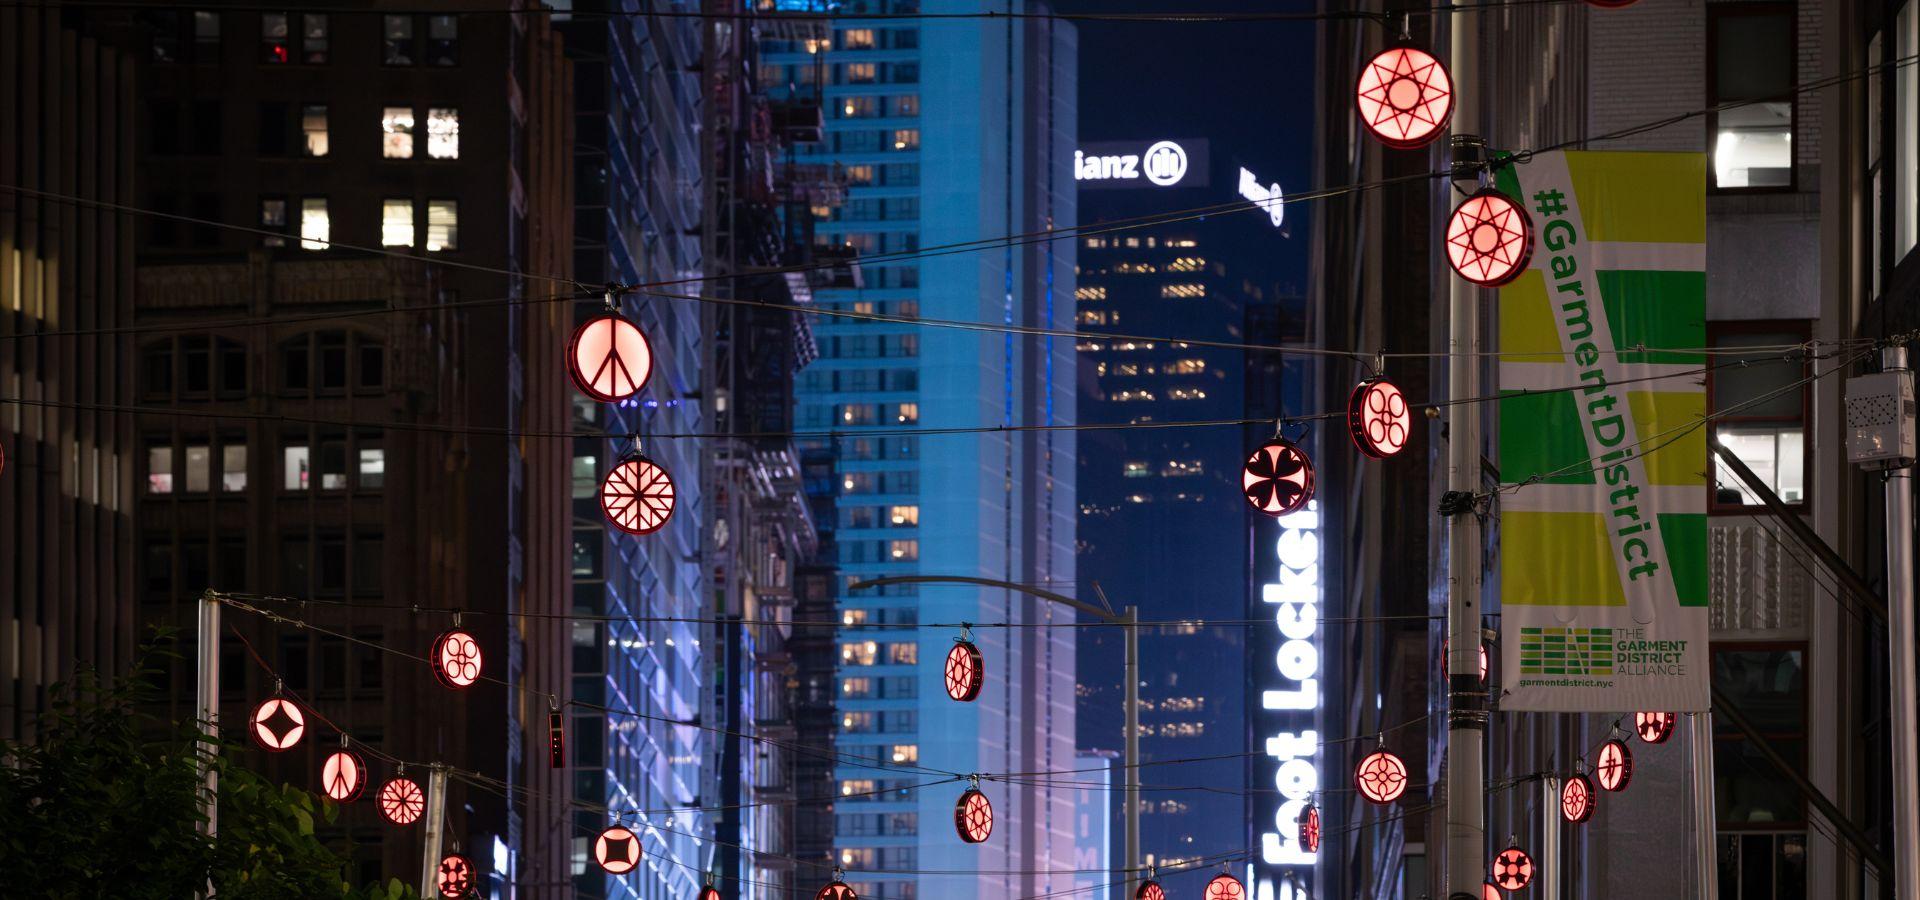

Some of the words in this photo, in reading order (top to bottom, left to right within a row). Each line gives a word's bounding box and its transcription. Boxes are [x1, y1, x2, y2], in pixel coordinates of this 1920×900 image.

[1533, 188, 1659, 581] #GarmentDistrict
[1617, 628, 1644, 639] THE
[1617, 641, 1687, 651] GARMENT
[1617, 653, 1682, 663] DISTRICT
[1617, 665, 1687, 675] ALLIANCE
[1520, 679, 1613, 689] garmentdistrict.nyc
[1262, 731, 1318, 864] Foot
